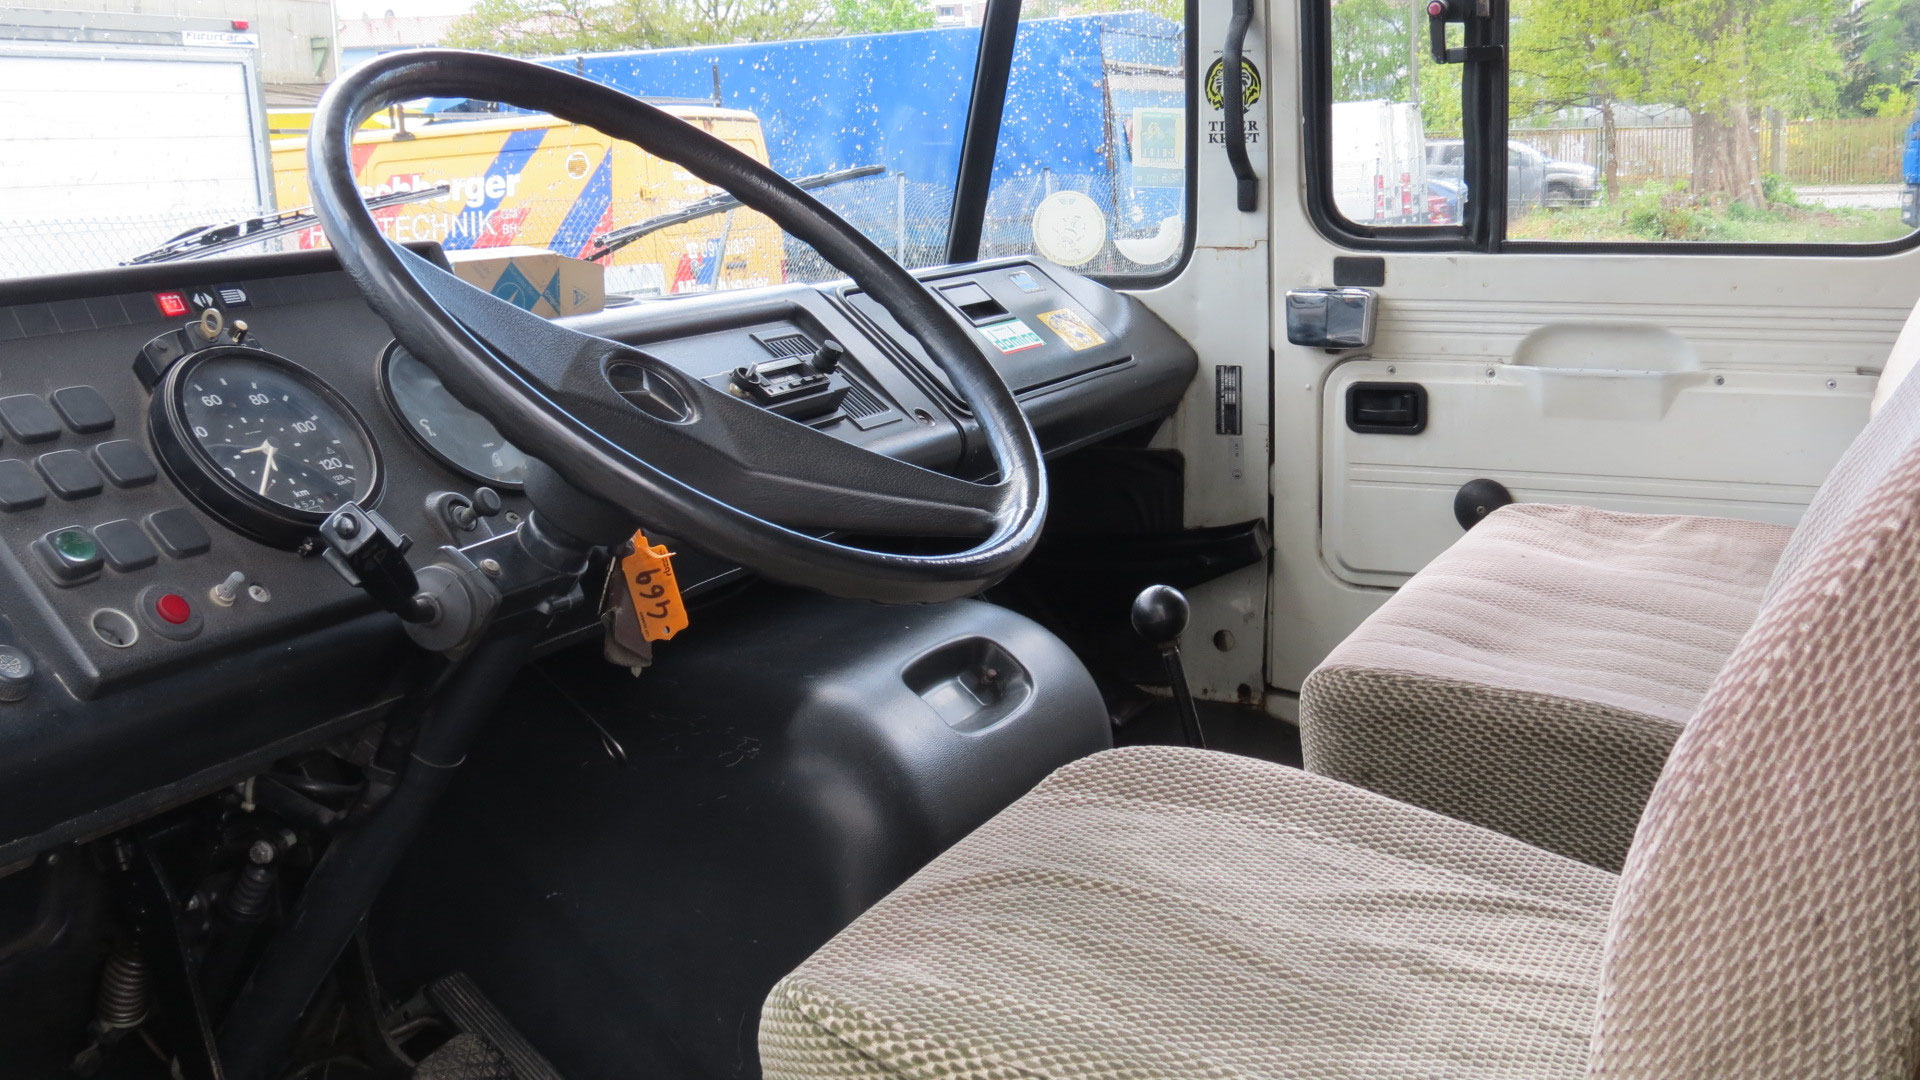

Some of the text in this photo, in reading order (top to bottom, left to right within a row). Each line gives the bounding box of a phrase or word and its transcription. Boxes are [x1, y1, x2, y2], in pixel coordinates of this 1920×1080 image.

[310, 37, 329, 77] 7
[1208, 120, 1259, 132] TIR
[201, 394, 223, 407] 60
[248, 393, 270, 406] 80
[291, 420, 317, 434] 100
[318, 457, 343, 471] 120
[292, 488, 311, 498] km
[635, 567, 671, 619] 469
